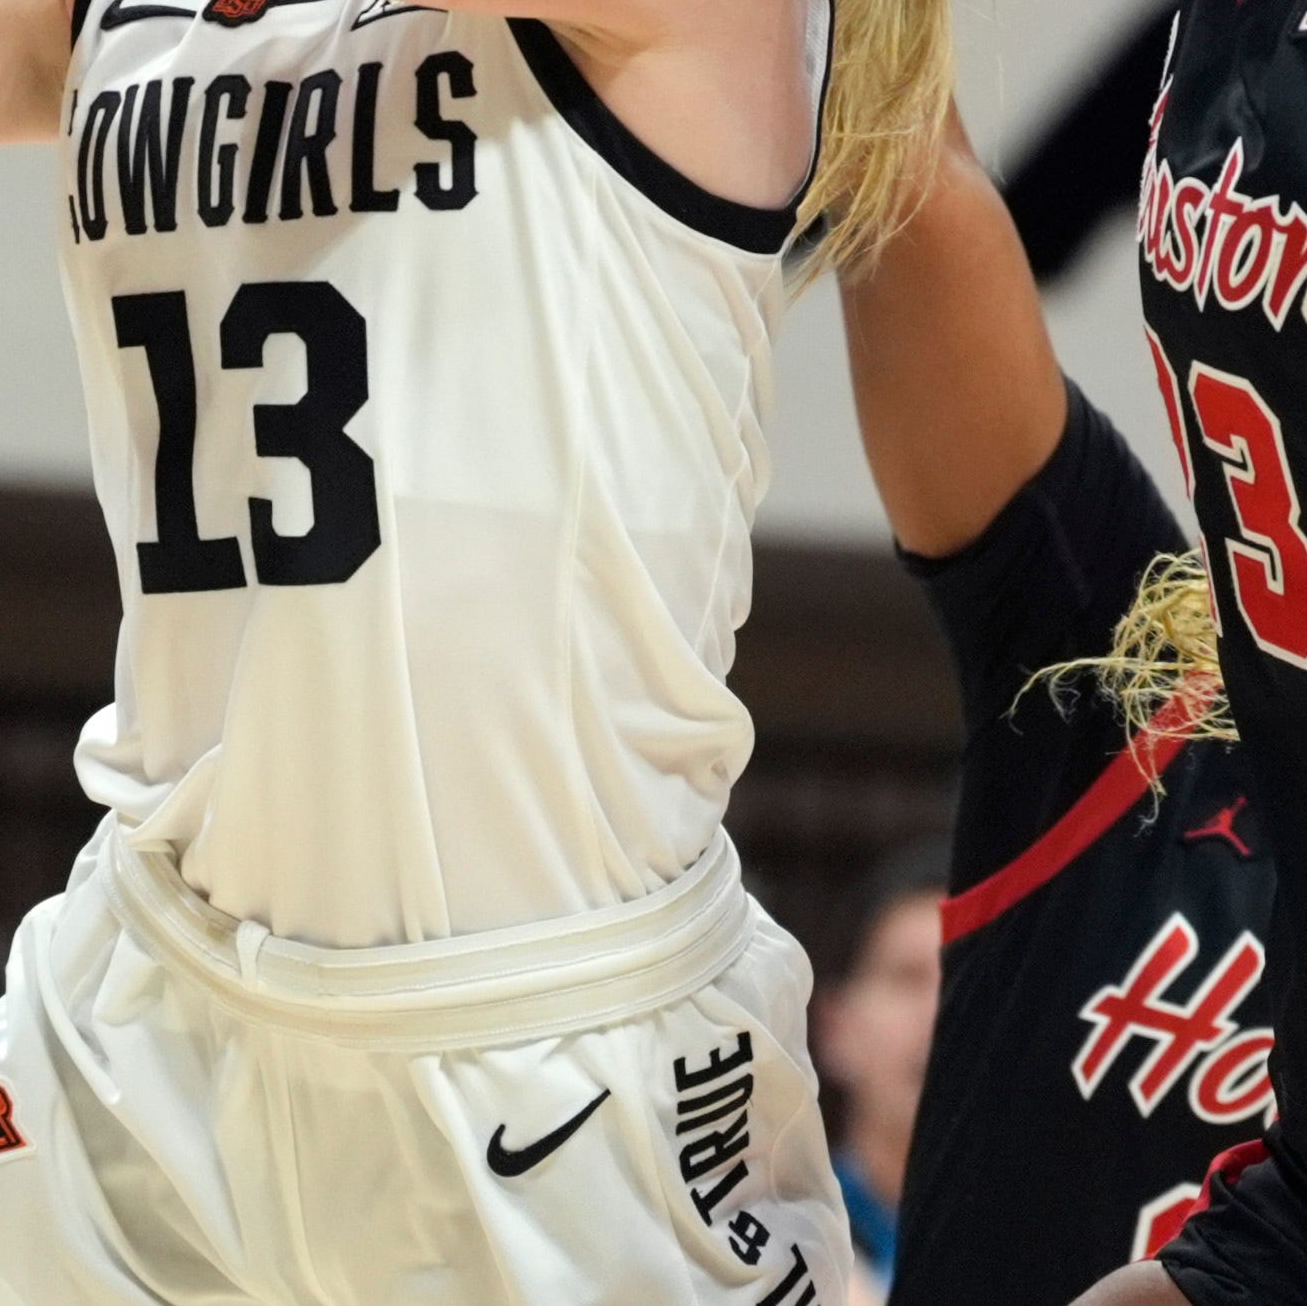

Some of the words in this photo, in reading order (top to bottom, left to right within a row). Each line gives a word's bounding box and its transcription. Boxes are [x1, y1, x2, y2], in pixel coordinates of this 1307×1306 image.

[68, 50, 478, 245] OWGIRLS
[111, 280, 383, 595] 13
[673, 1030, 754, 1228] TRUE
[728, 1210, 771, 1266] &
